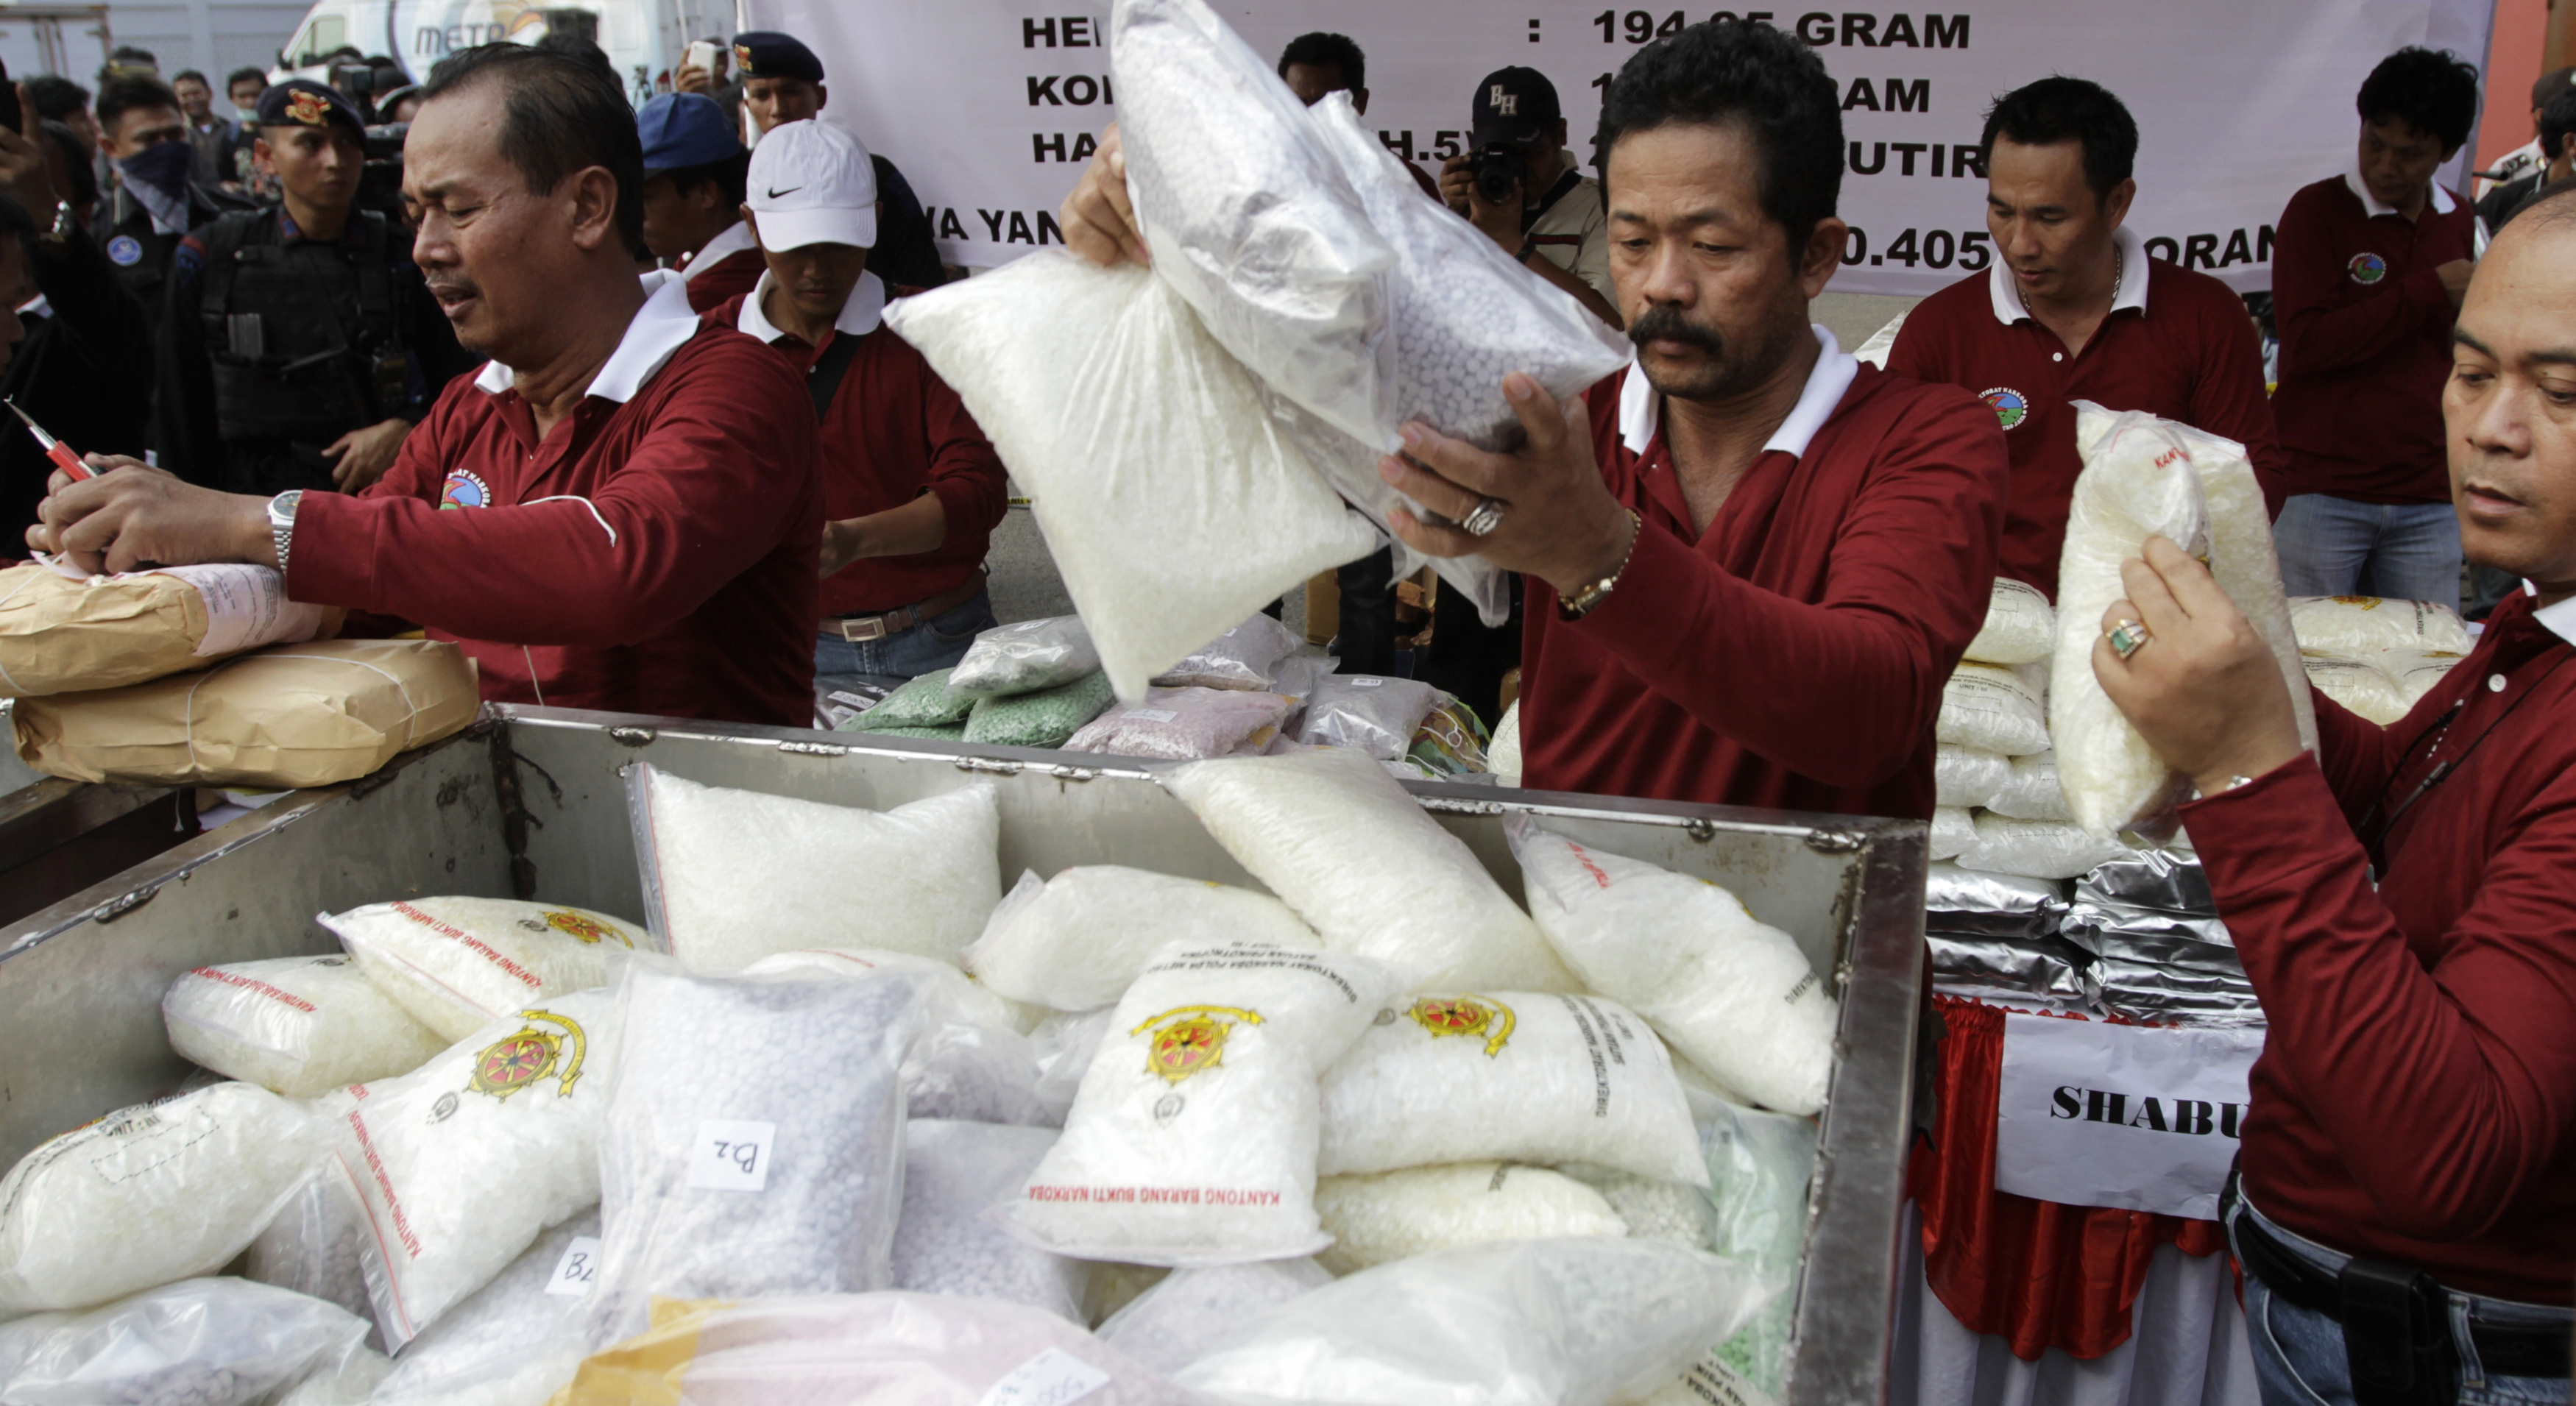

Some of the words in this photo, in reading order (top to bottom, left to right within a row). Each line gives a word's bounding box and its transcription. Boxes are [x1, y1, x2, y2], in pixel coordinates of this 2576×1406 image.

[1022, 17, 1102, 48] HE
[1795, 12, 1971, 49] GRAM
[1490, 83, 1518, 117] BH
[1830, 77, 1931, 113] AM
[1848, 141, 1988, 179] UTIR
[1839, 226, 1991, 271] 0.405
[2003, 387, 2028, 409] NARKOBA
[467, 472, 492, 509] NARKOBA
[1958, 683, 1976, 691] UNIT
[389, 900, 433, 927] NARKOBA
[431, 920, 464, 942] BUKTI
[460, 934, 502, 963] BARANG
[495, 958, 542, 990] KANTONG
[1189, 960, 1228, 971] POLDA
[1229, 959, 1287, 970] NARKOBA
[1288, 961, 1358, 1005] DIREKTORAT
[277, 992, 317, 1014] KANTONG
[2050, 1085, 2250, 1139] SHABU
[364, 1141, 381, 1174] BUKTI
[375, 1166, 397, 1210] BARANG
[1029, 1184, 1089, 1203] NARKOBA
[1093, 1185, 1136, 1204] BUKTI
[1140, 1186, 1200, 1205] BARANG
[1205, 1187, 1281, 1207] KANTONG
[392, 1204, 422, 1260] KANTONG
